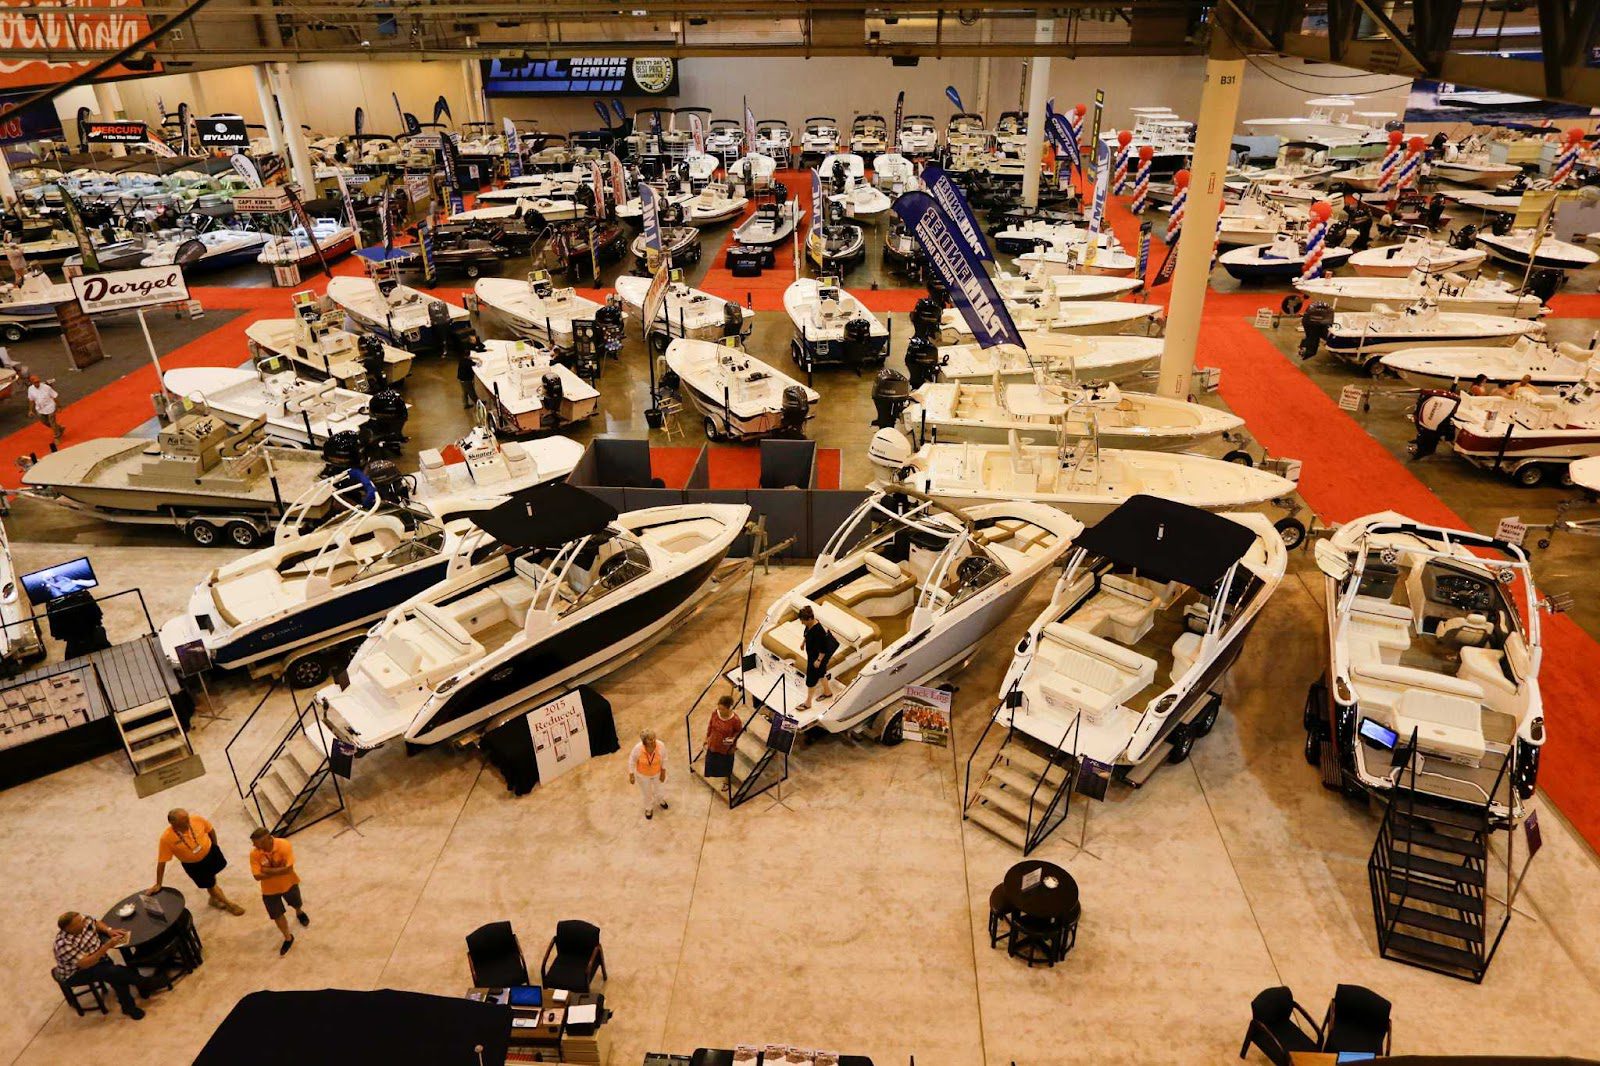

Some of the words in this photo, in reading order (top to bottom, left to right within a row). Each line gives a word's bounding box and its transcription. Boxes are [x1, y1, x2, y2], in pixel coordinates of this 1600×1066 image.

[571, 66, 627, 78] CENTER
[1220, 75, 1236, 85] B31
[91, 126, 144, 134] MERCURY
[83, 273, 177, 302] Dargel
[545, 699, 566, 717] 2015
[534, 705, 577, 733] Reduced
